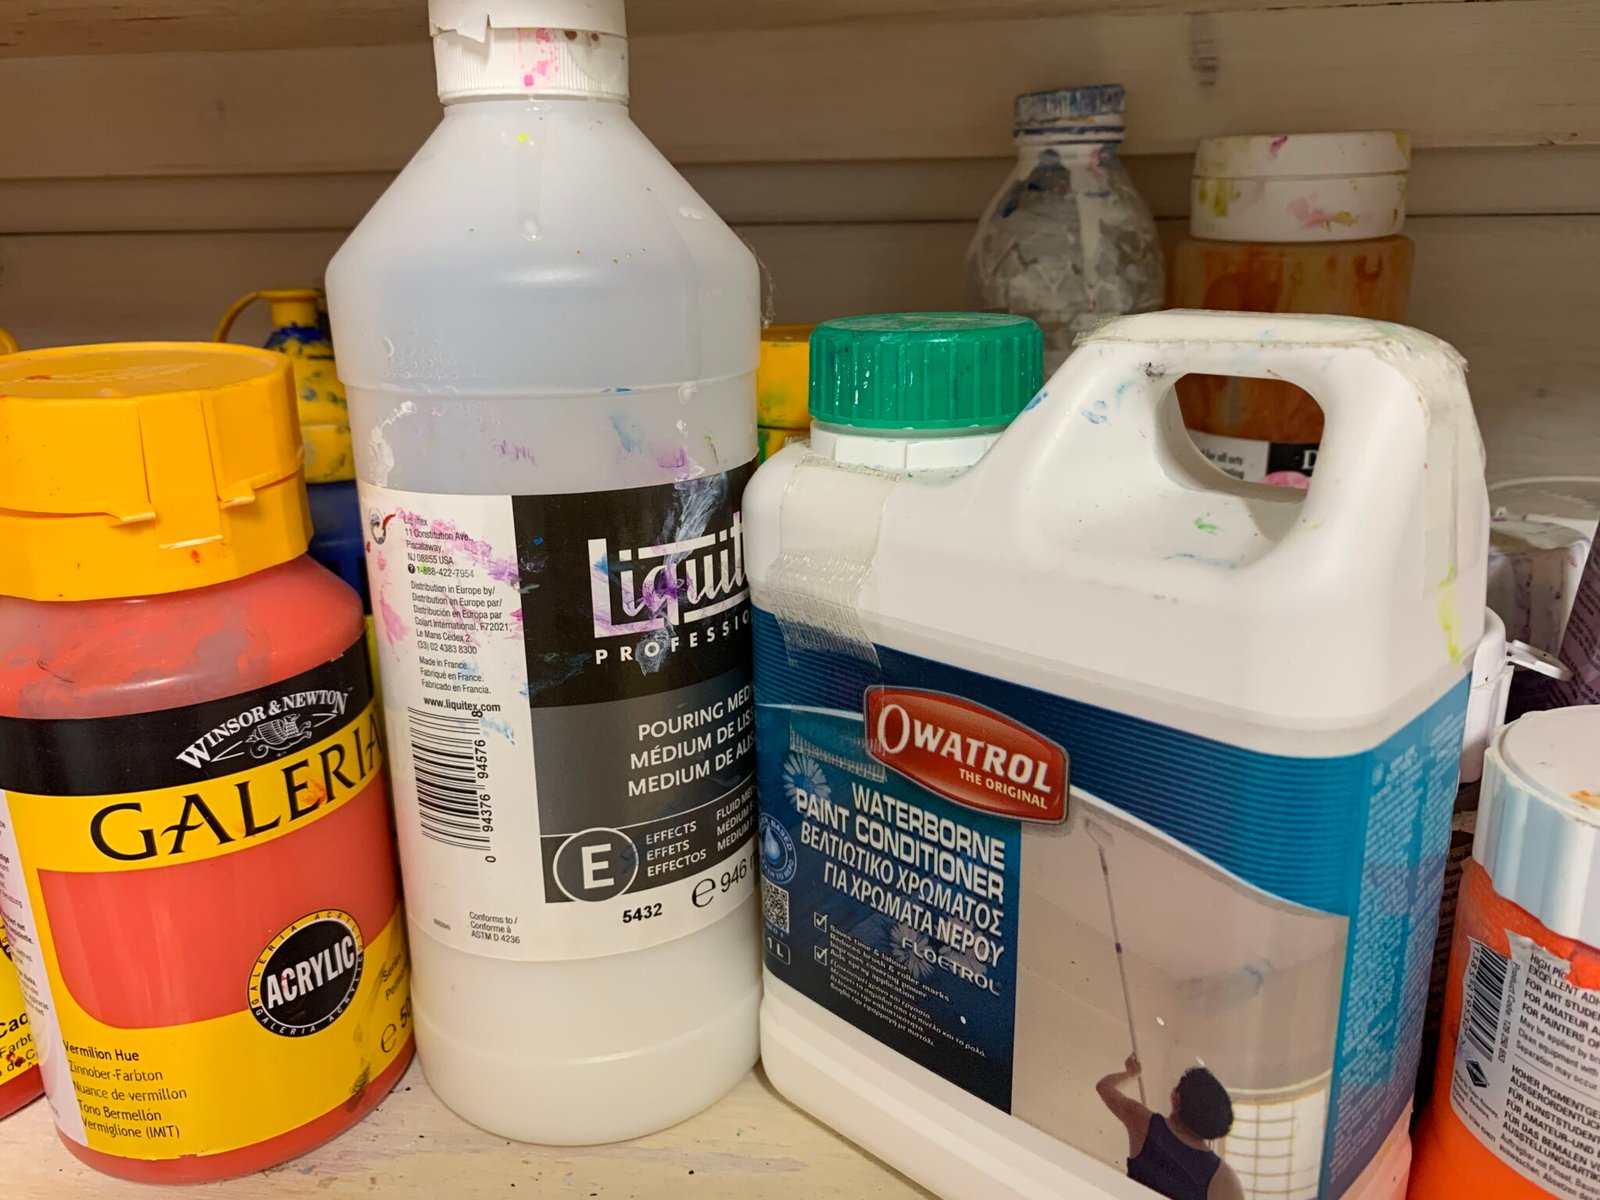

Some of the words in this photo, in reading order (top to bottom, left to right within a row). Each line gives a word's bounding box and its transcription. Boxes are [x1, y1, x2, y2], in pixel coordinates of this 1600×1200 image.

[414, 529, 453, 540] Constitution
[408, 553, 416, 561] NJ
[439, 556, 454, 564] USA
[417, 566, 474, 578] 1-888-422-7954
[411, 581, 447, 592] Distribution
[448, 585, 454, 593] in
[456, 584, 482, 596] Europe
[412, 593, 448, 605] Distribution
[460, 598, 485, 607] Europe
[487, 598, 502, 608] par/
[414, 605, 450, 617] Distribución
[462, 611, 488, 620] Europa
[490, 612, 502, 620] par
[415, 617, 432, 628] Colart
[434, 619, 479, 632] International,
[416, 629, 423, 637] Le
[425, 630, 442, 641] Mans
[418, 641, 429, 651] (33)
[430, 643, 438, 651] 02
[440, 644, 457, 653] 4383
[459, 645, 477, 654] 8300
[419, 656, 435, 666] Made
[437, 658, 443, 667] in
[444, 660, 469, 670] France.
[420, 667, 446, 680] Fabriqué
[458, 672, 484, 682] France.
[422, 679, 451, 692] Fabricado
[453, 684, 461, 692] en
[462, 683, 491, 694] Francia.
[424, 697, 501, 712] www.liquitex.com
[472, 710, 483, 718] 8
[176, 706, 266, 768] WINSOR
[268, 700, 282, 716] &
[282, 690, 348, 714] NEWTON
[638, 702, 724, 742] POURING
[630, 732, 711, 770] MÉDIUM
[717, 722, 734, 744] DE
[878, 704, 1051, 793] OWATROL
[474, 739, 489, 779] 94576
[628, 760, 710, 797] MEDIUM
[715, 750, 733, 770] DE
[90, 712, 382, 861] GALERIA
[959, 768, 982, 786] THE
[985, 778, 1048, 810] ORIGINAL
[480, 794, 494, 833] 94376
[717, 798, 740, 821] FLUID
[717, 804, 749, 836] MÉDIUM
[646, 821, 696, 844] EFFECTS
[718, 820, 749, 852] MEDIUM
[852, 782, 1006, 870] WATERBORNE
[647, 840, 690, 861] EFFETS
[796, 788, 850, 833] PAINT
[856, 814, 1004, 905] CONDITIONER
[581, 844, 614, 889] E
[647, 849, 706, 877] EFFECTOS
[720, 858, 747, 892] 946
[801, 821, 894, 884] ΒΕΛΤΙΩΤΙΚΟ
[896, 866, 1004, 937] ΧΡΩΜΑΤΟΣ
[469, 911, 504, 923] Conforms
[506, 916, 513, 924] to
[622, 903, 662, 923] 5432
[824, 862, 847, 893] ΓΙΑ
[851, 876, 936, 937] ΧΡΩΜΑΤΑ
[936, 919, 1004, 968] ΝΕΡΟΥ
[470, 921, 504, 933] Conforme
[506, 925, 512, 934] à
[471, 930, 492, 940] ASTM
[501, 934, 520, 944] 4236
[767, 937, 772, 949] 1
[777, 943, 784, 958] L
[267, 936, 355, 1010] ACRYLIC
[863, 951, 886, 968] brush
[897, 971, 920, 986] roller
[902, 936, 1000, 995] FLOETROL
[1531, 952, 1550, 971] HIGH
[1526, 977, 1542, 994] FOR
[1545, 989, 1562, 1004] ART
[1529, 964, 1578, 996] EXCELLENT
[256, 1009, 316, 1035] GALERIA
[1524, 990, 1541, 1006] FOR
[1543, 1003, 1589, 1031] AMATEUR
[1522, 1002, 1538, 1019] FOR
[1540, 1014, 1585, 1043] PAINTERS
[63, 1040, 112, 1060] Vermilion
[114, 1049, 139, 1061] Hue
[68, 1060, 163, 1081] Zinnober-Farbton
[1512, 1064, 1540, 1088] HOHER
[73, 1080, 108, 1098] Nuance
[111, 1089, 125, 1100] de
[128, 1088, 187, 1101] vermillon
[1508, 1086, 1524, 1103] FÜR
[77, 1099, 101, 1116] Tono
[103, 1108, 162, 1121] Bermellón
[1506, 1098, 1522, 1115] FÜR
[82, 1117, 142, 1138] Vermiglione
[146, 1125, 180, 1139] (IMIT)
[1504, 1110, 1520, 1127] FÜR
[1522, 1123, 1539, 1140] DAS
[1542, 1136, 1587, 1165] BEMALEN
